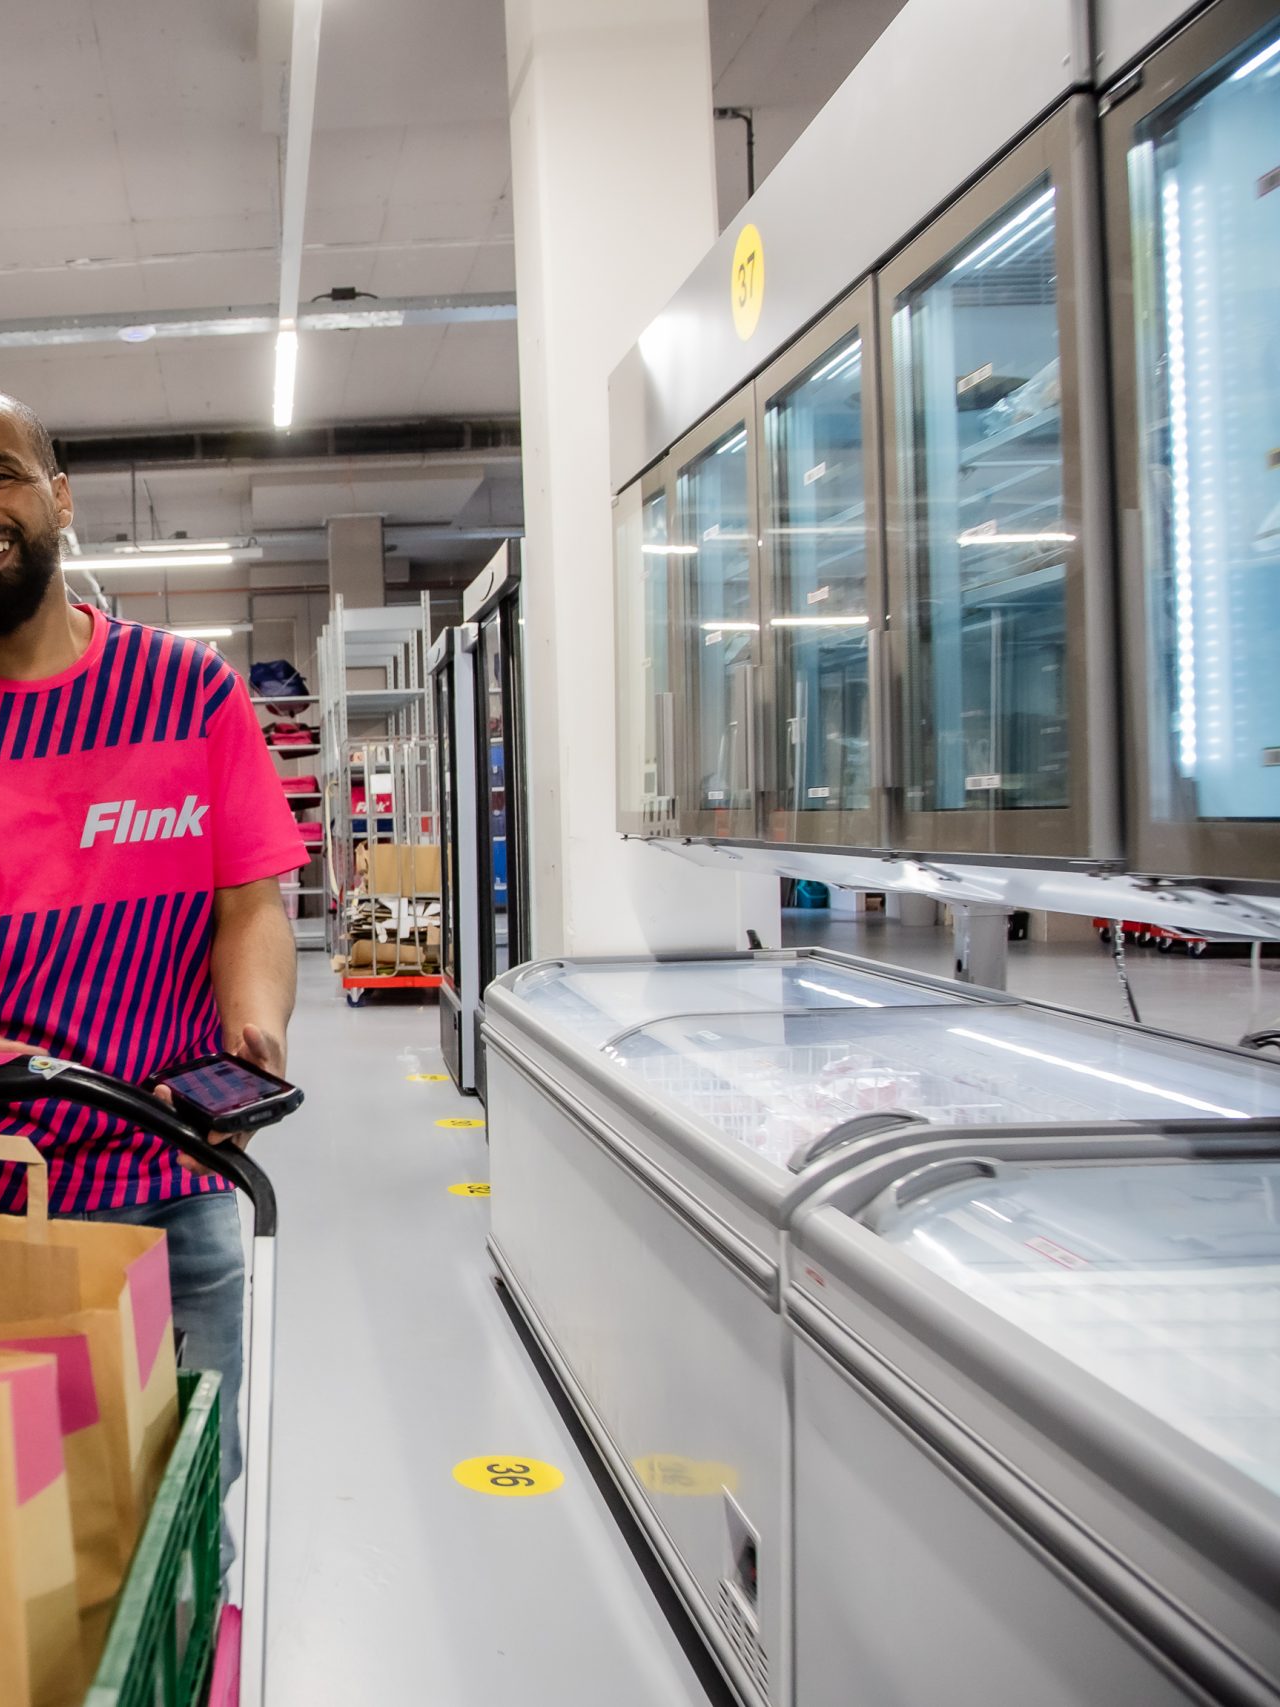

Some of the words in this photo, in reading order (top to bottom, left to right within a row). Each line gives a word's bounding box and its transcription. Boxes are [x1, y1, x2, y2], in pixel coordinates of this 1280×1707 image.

[737, 250, 756, 308] 37
[80, 795, 210, 849] Flink
[486, 1463, 535, 1488] 36
